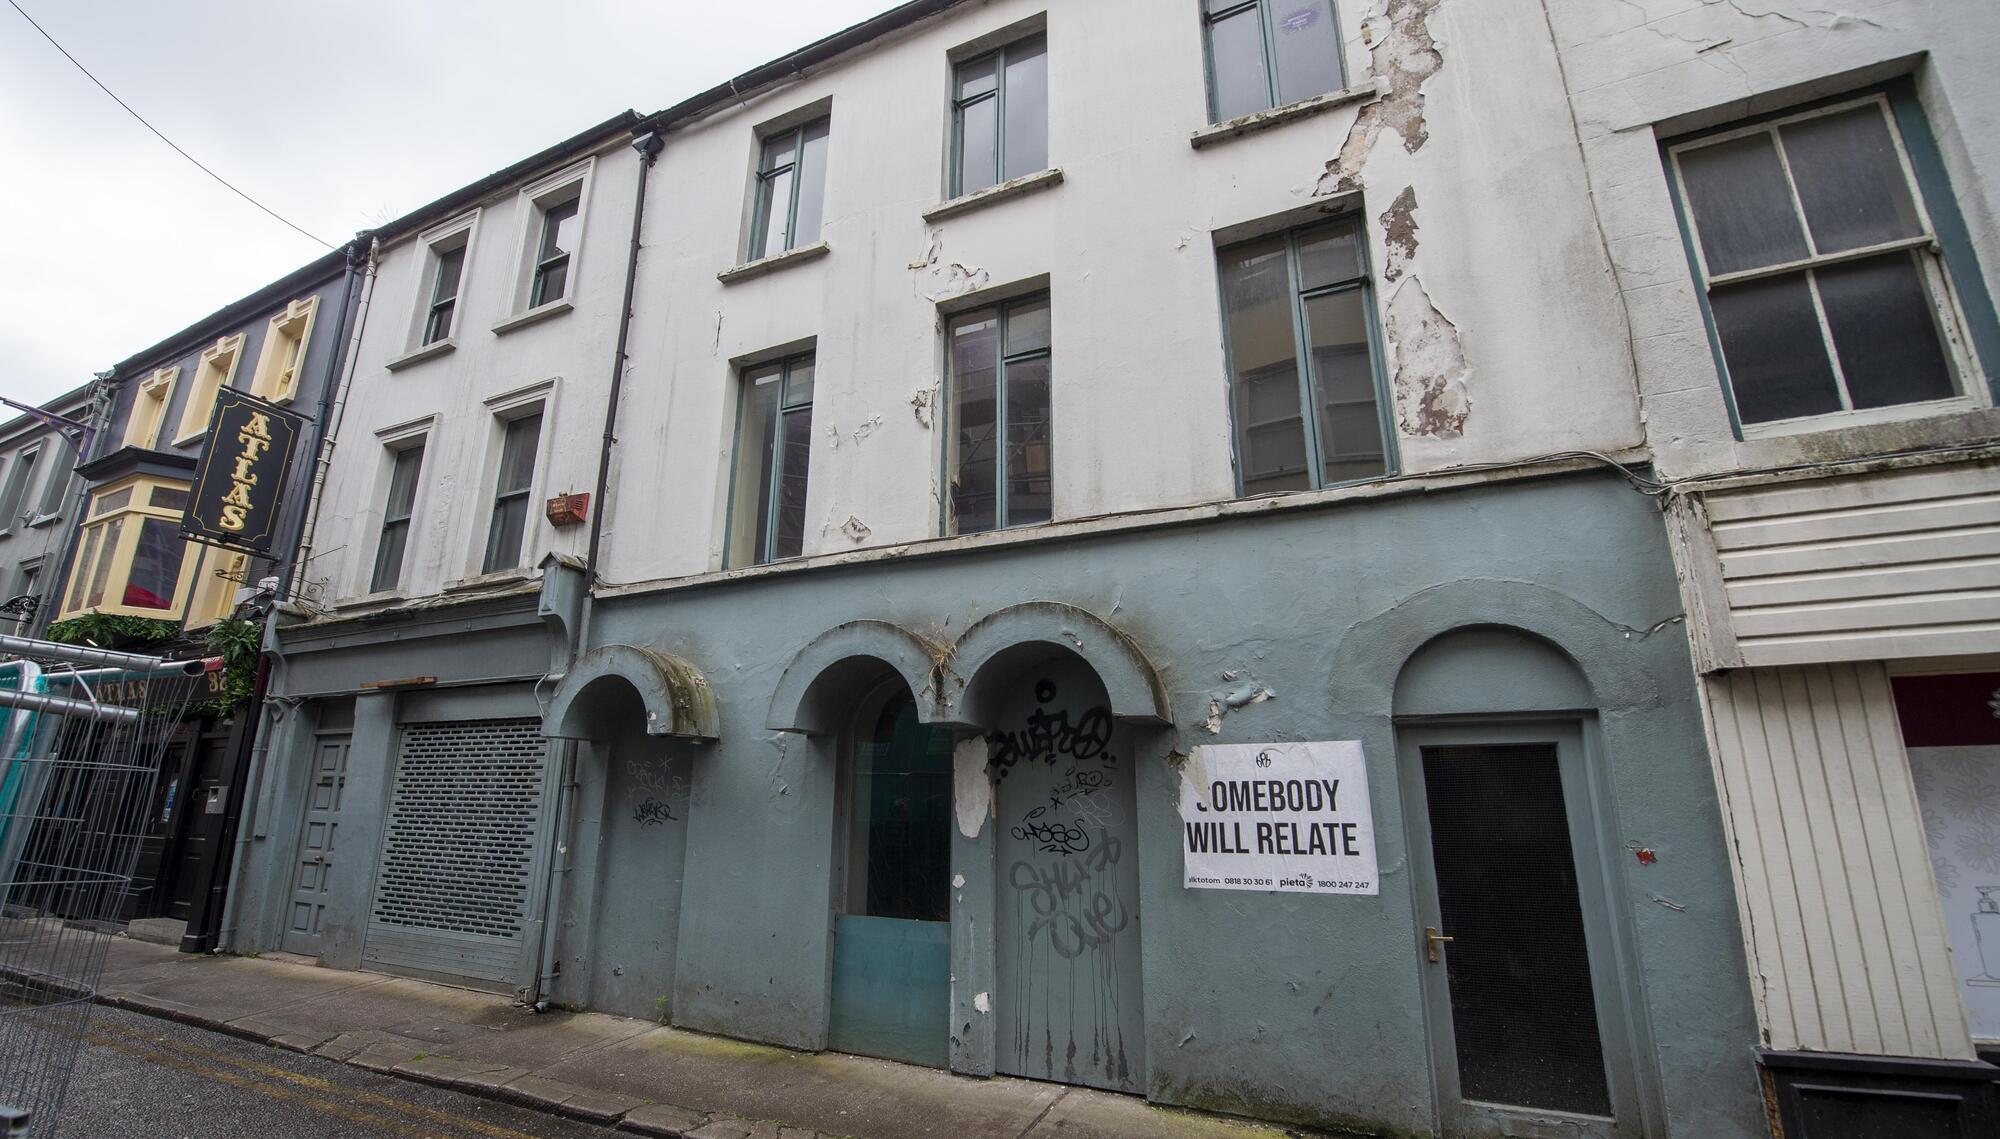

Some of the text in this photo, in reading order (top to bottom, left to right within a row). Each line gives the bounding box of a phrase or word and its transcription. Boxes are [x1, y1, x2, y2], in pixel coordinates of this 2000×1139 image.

[219, 411, 273, 531] ATLAS
[1186, 822, 1360, 856] WILL RELATE
[1224, 877, 1241, 885] 0818
[1254, 878, 1264, 886] 30
[1280, 878, 1306, 887] pieta
[1317, 880, 1337, 888] 1800
[1355, 881, 1370, 889] 247
